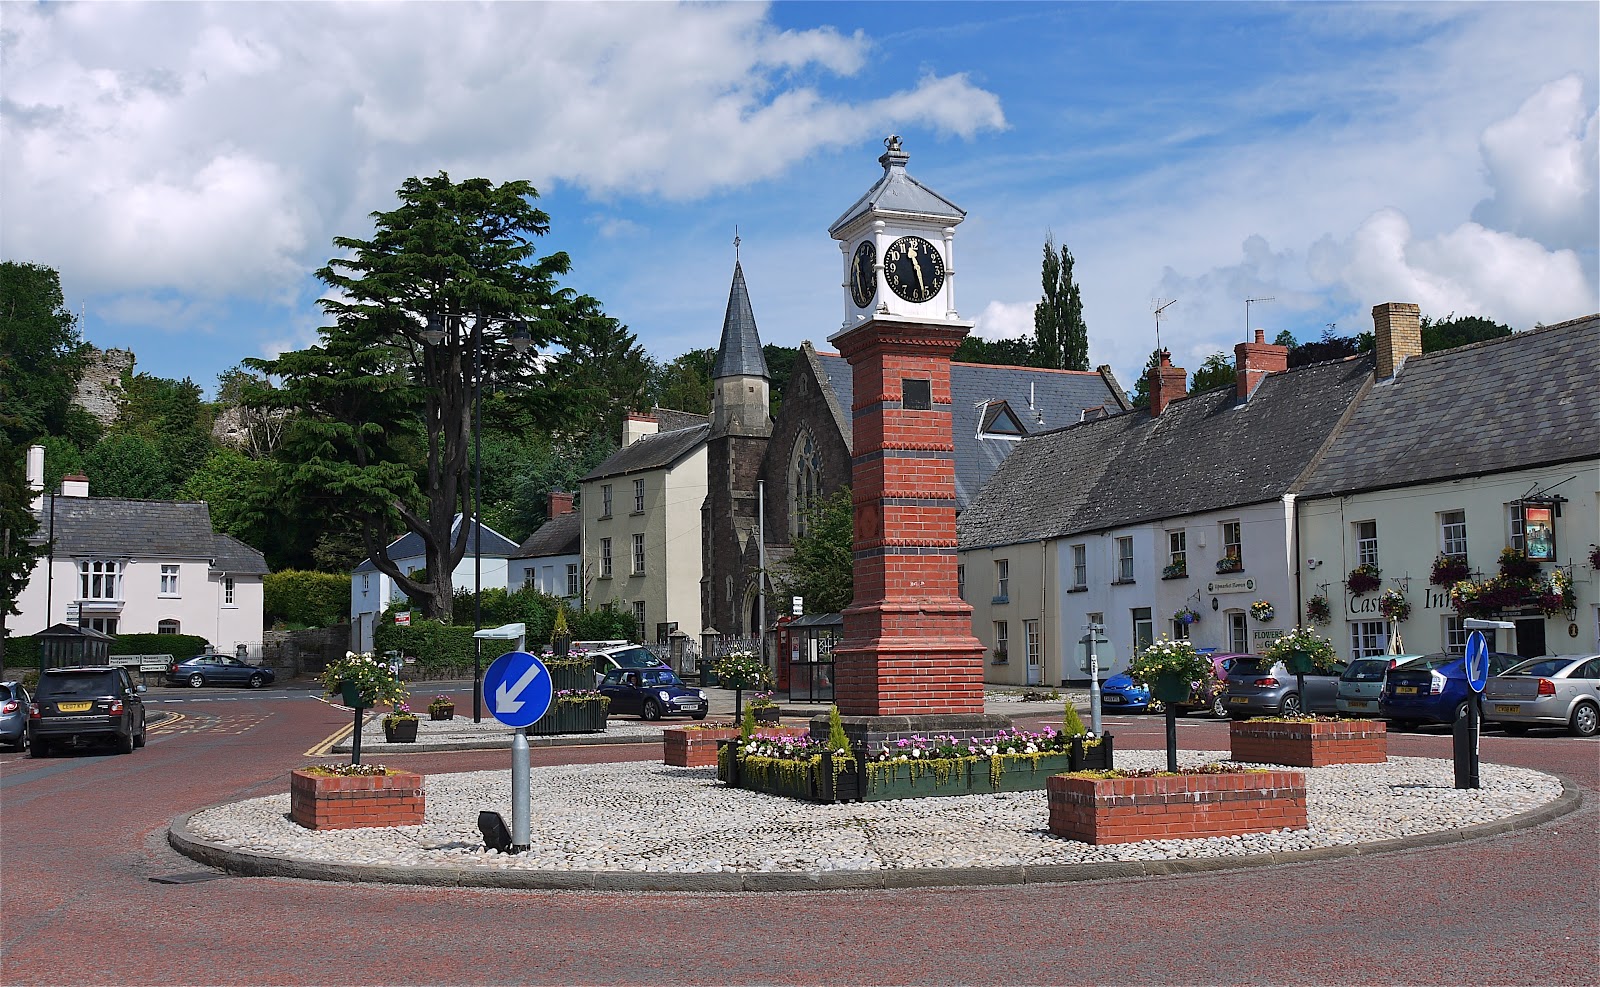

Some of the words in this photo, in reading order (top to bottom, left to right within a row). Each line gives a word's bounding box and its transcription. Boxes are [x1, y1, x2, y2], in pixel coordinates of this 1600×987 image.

[900, 244, 906, 254] 11
[910, 240, 918, 250] 12
[923, 244, 927, 254] 1
[891, 251, 900, 260] 10
[931, 254, 936, 263] 2
[890, 263, 896, 273] 9
[934, 266, 940, 276] 3
[894, 275, 899, 286] 8
[932, 278, 938, 288] 4
[902, 284, 908, 294] 7
[913, 288, 918, 298] 6
[924, 286, 930, 296] 5
[1350, 594, 1385, 614] Cast
[1254, 630, 1283, 639] FLOWERS
